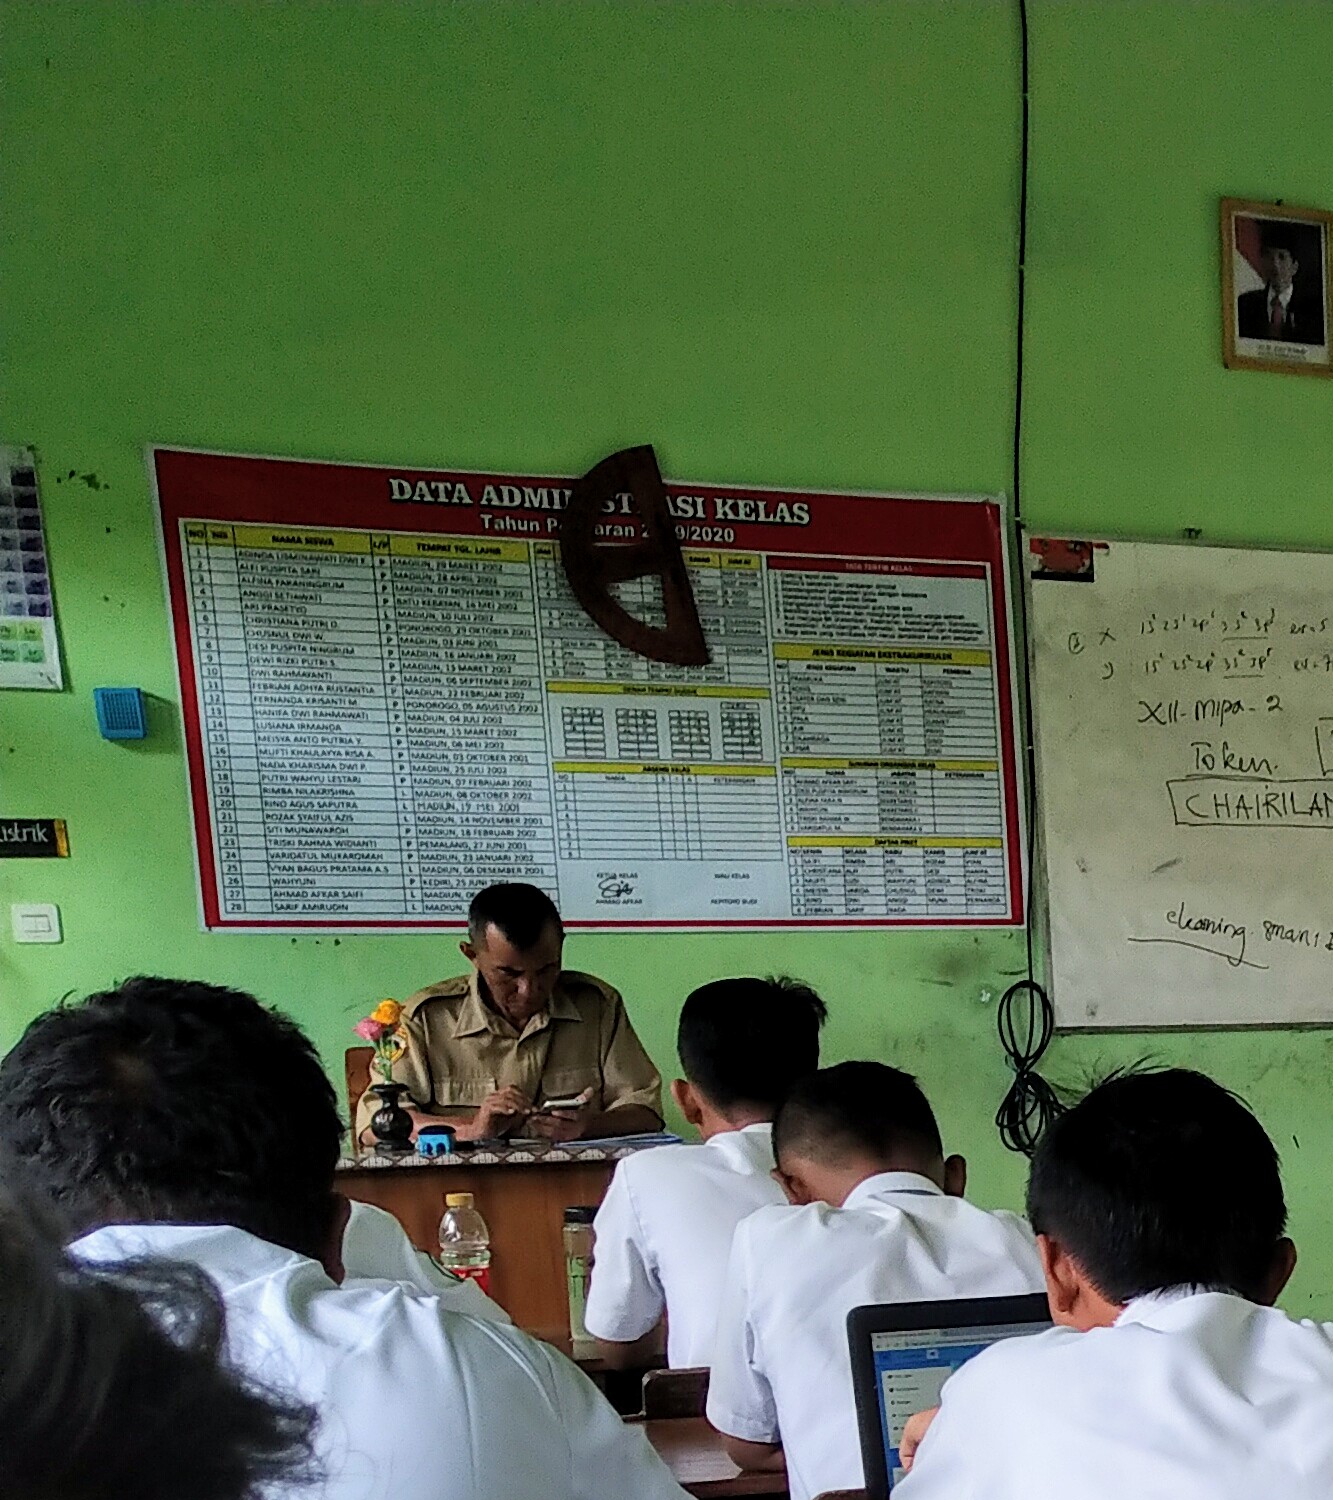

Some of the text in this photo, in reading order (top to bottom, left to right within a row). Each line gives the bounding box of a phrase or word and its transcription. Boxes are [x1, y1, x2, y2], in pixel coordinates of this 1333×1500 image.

[389, 478, 473, 504] DATA
[714, 497, 810, 525] KELAS
[481, 514, 540, 533] Tahun
[0, 822, 49, 842] istrik
